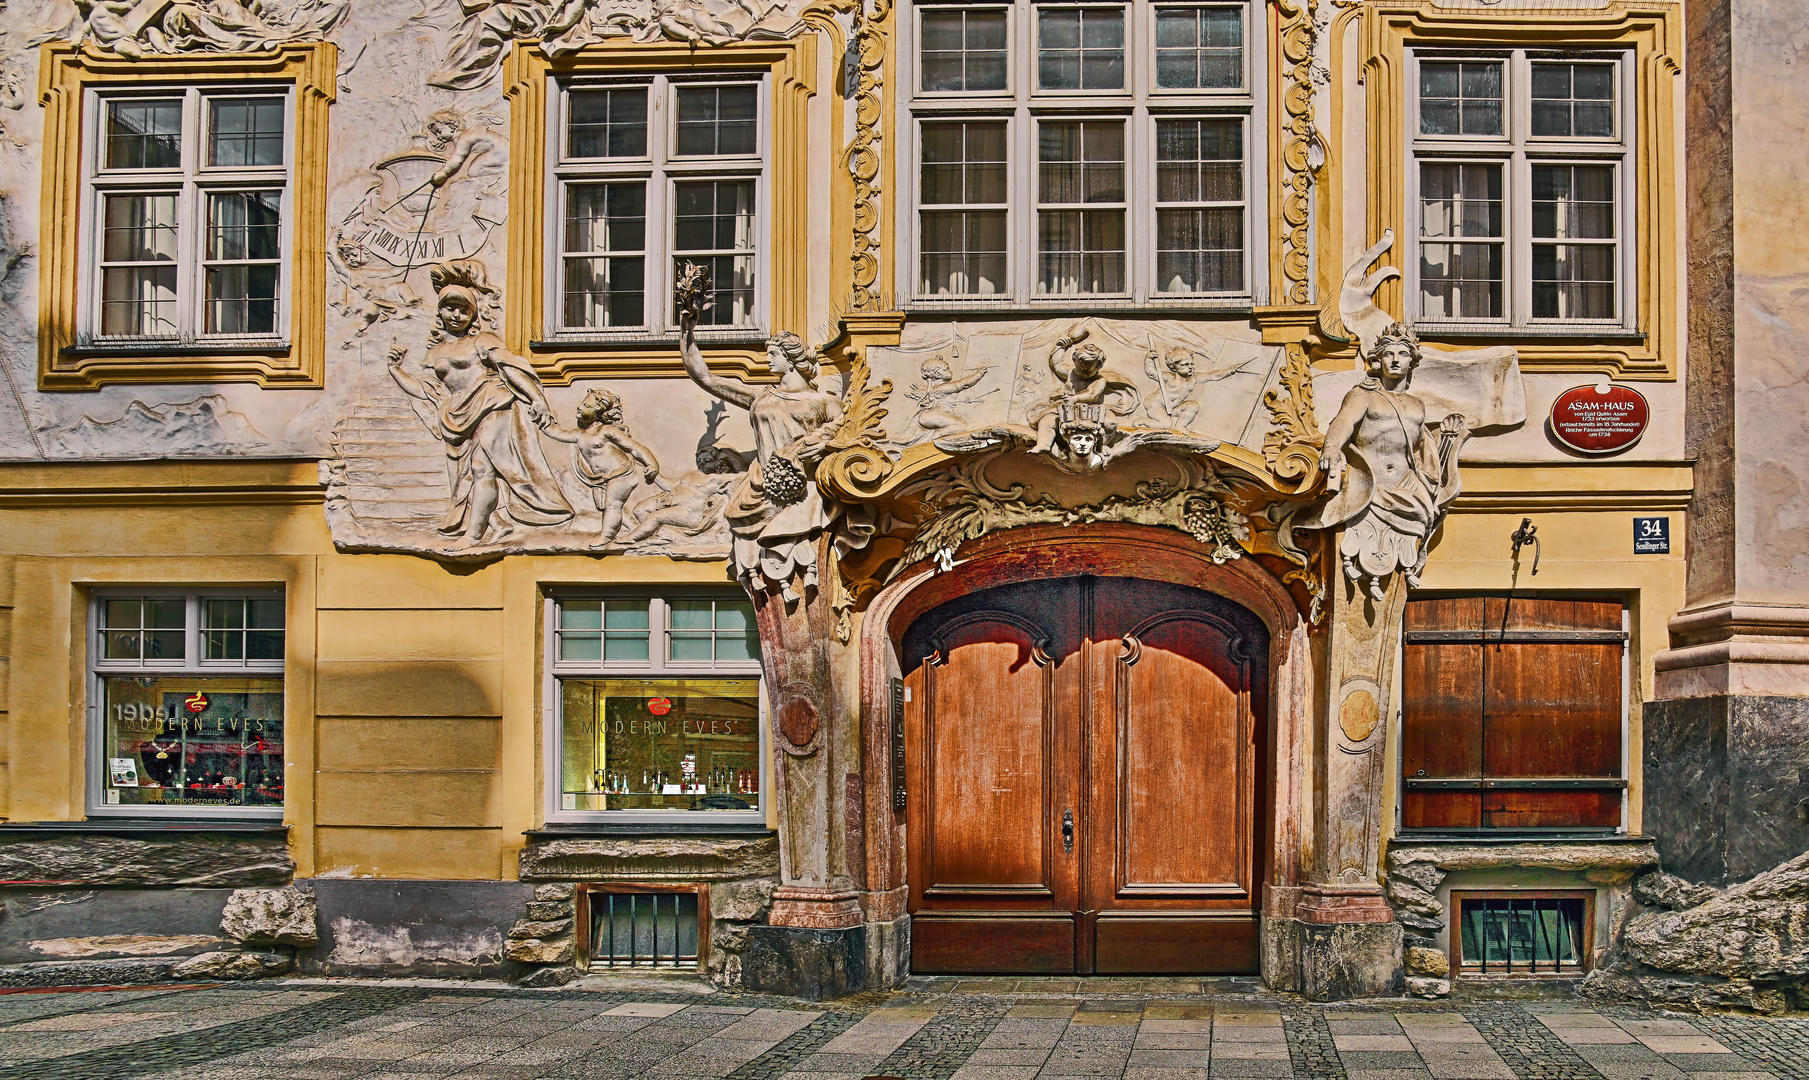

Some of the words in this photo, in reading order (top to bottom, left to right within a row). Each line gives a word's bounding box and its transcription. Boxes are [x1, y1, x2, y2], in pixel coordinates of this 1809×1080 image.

[387, 236, 403, 254] IX
[399, 240, 414, 258] X
[417, 240, 428, 259] XI
[432, 237, 445, 258] XII
[1567, 401, 1635, 411] ASAM-HAUS
[1641, 519, 1662, 537] 34
[1636, 541, 1660, 552] Sendlinger
[1660, 541, 1668, 550] Str.
[124, 717, 203, 731] MODERN
[217, 717, 264, 731] EVES
[581, 720, 667, 734] MODERN
[683, 720, 733, 734] EVES
[150, 796, 241, 805] www.moderneves.de
